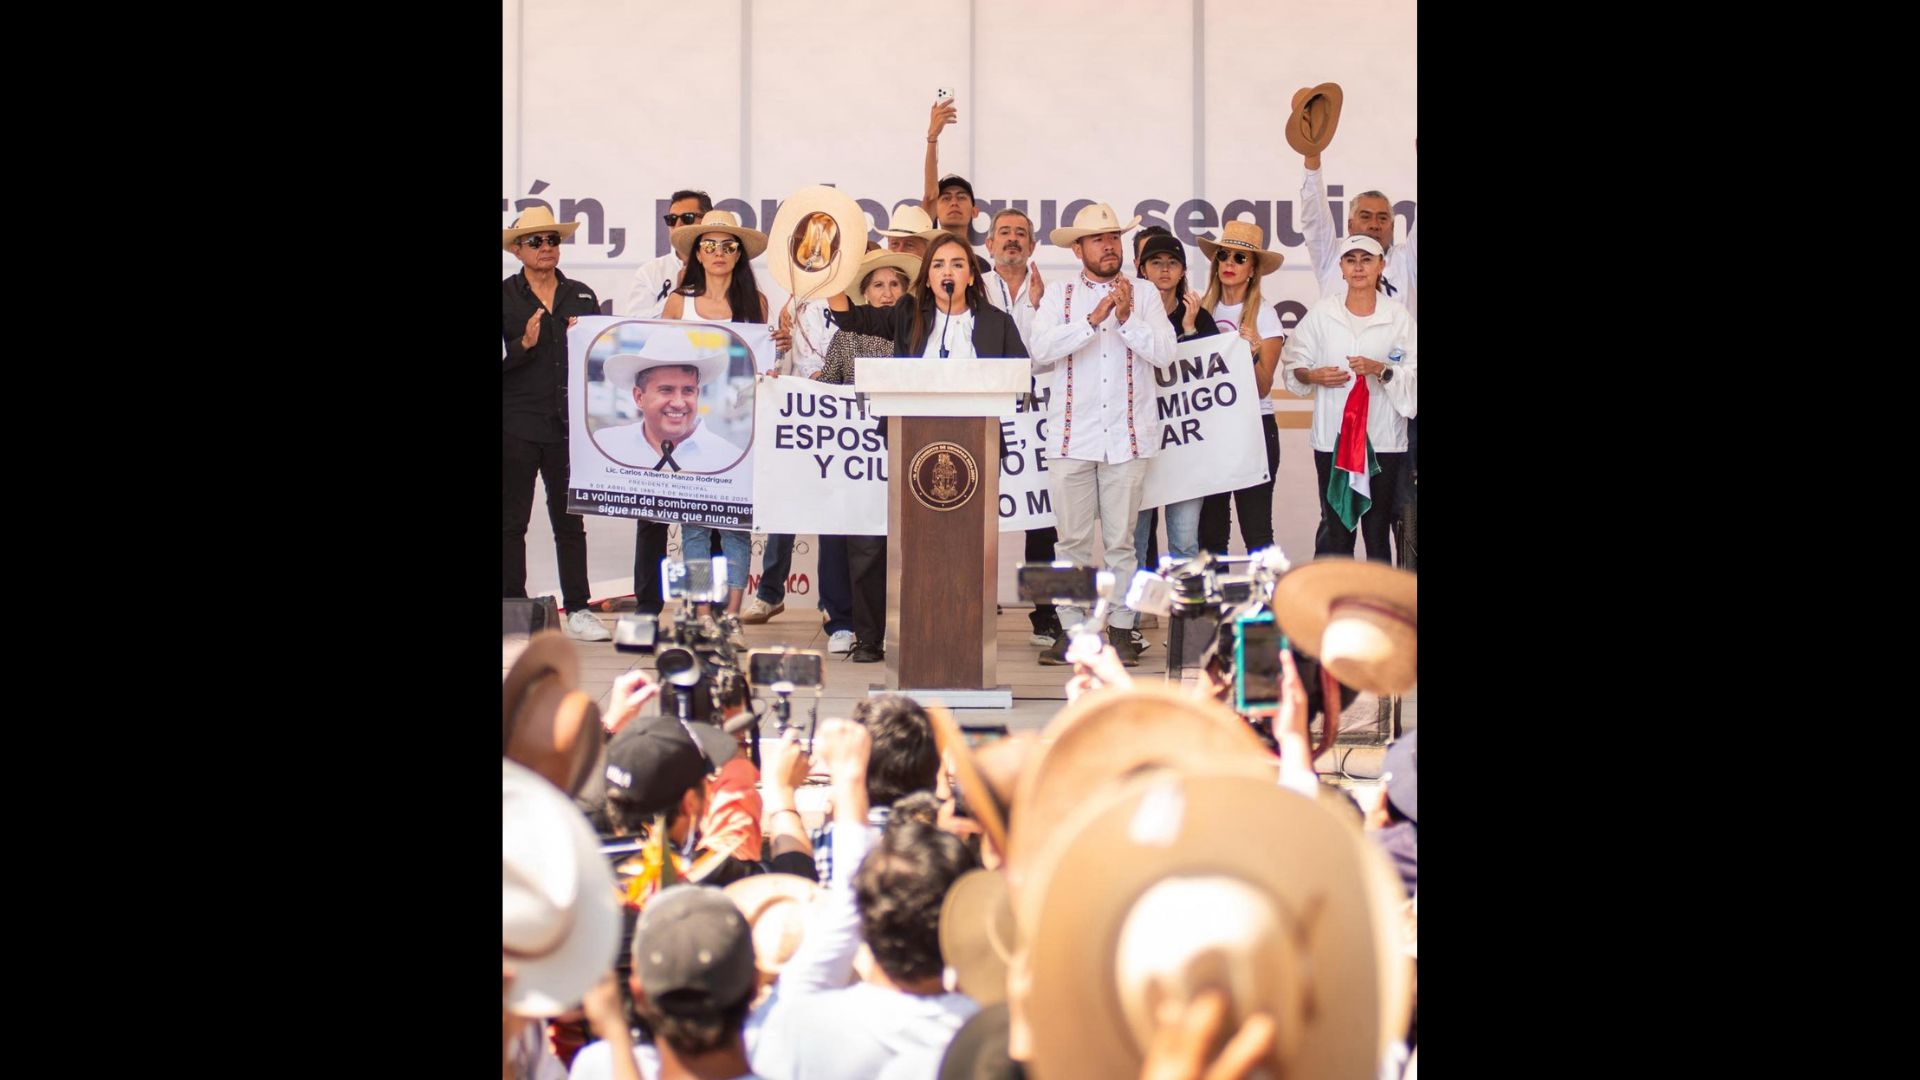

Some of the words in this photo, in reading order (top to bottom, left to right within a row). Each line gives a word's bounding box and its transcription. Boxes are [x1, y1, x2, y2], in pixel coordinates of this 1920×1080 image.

[1153, 352, 1230, 388] UNA
[775, 424, 888, 453] ESPOS
[605, 466, 619, 474] Lic.
[619, 468, 642, 476] Carlos
[643, 470, 670, 479] Alberto
[671, 473, 694, 481] Manzo
[813, 454, 835, 479] Y
[671, 484, 708, 492] MUNICIPAL
[679, 492, 717, 500] NOVIEMBRE
[575, 489, 589, 500] La
[591, 492, 637, 504] voluntad
[639, 494, 655, 506] del
[657, 499, 708, 511] sombrero
[710, 504, 725, 513] no
[598, 503, 629, 516] sigue
[630, 506, 654, 517] más
[656, 508, 679, 519] viva
[681, 512, 703, 523] que
[705, 514, 739, 525] nunca
